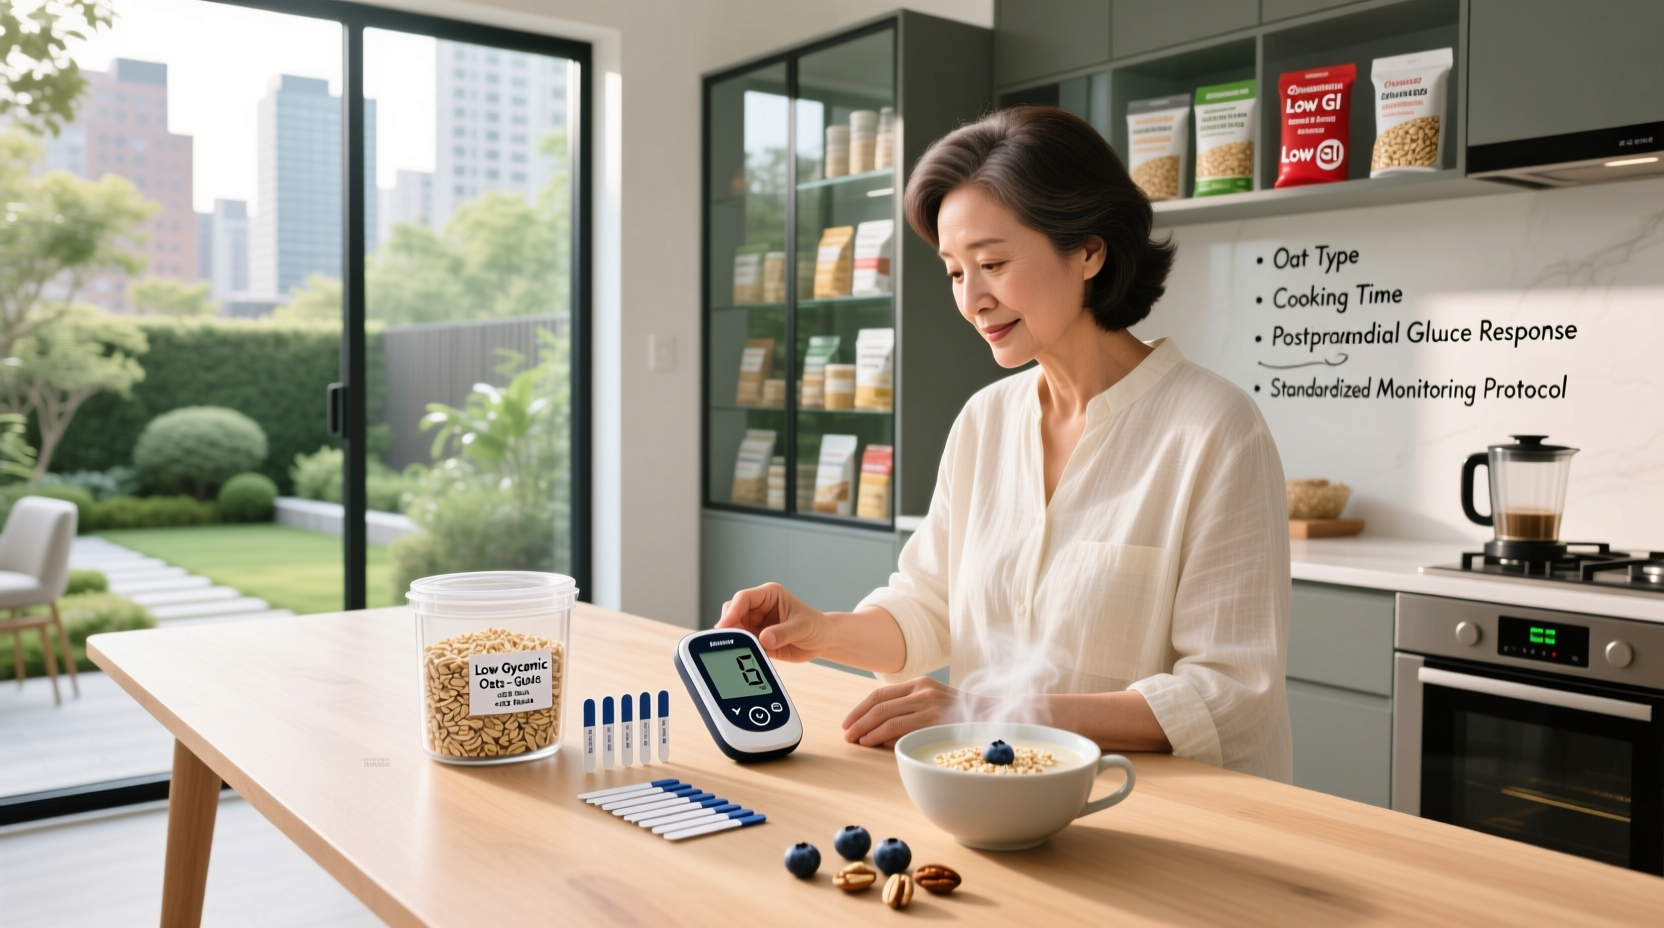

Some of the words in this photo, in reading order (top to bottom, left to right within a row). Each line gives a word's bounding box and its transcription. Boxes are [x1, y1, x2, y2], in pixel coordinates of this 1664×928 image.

[1286, 98, 1318, 113] Low
[1322, 93, 1341, 110] GI
[1281, 146, 1314, 163] Low
[1273, 247, 1309, 269] Oat
[1315, 245, 1359, 274] Type
[1273, 285, 1348, 313] Cooking
[1356, 283, 1403, 305] Time
[1480, 319, 1578, 348] Response
[1271, 376, 1371, 398] Standardized
[1376, 377, 1476, 407] Monitoring
[1484, 374, 1568, 399] Protocol
[475, 664, 498, 675] Low
[736, 654, 764, 686] 6
